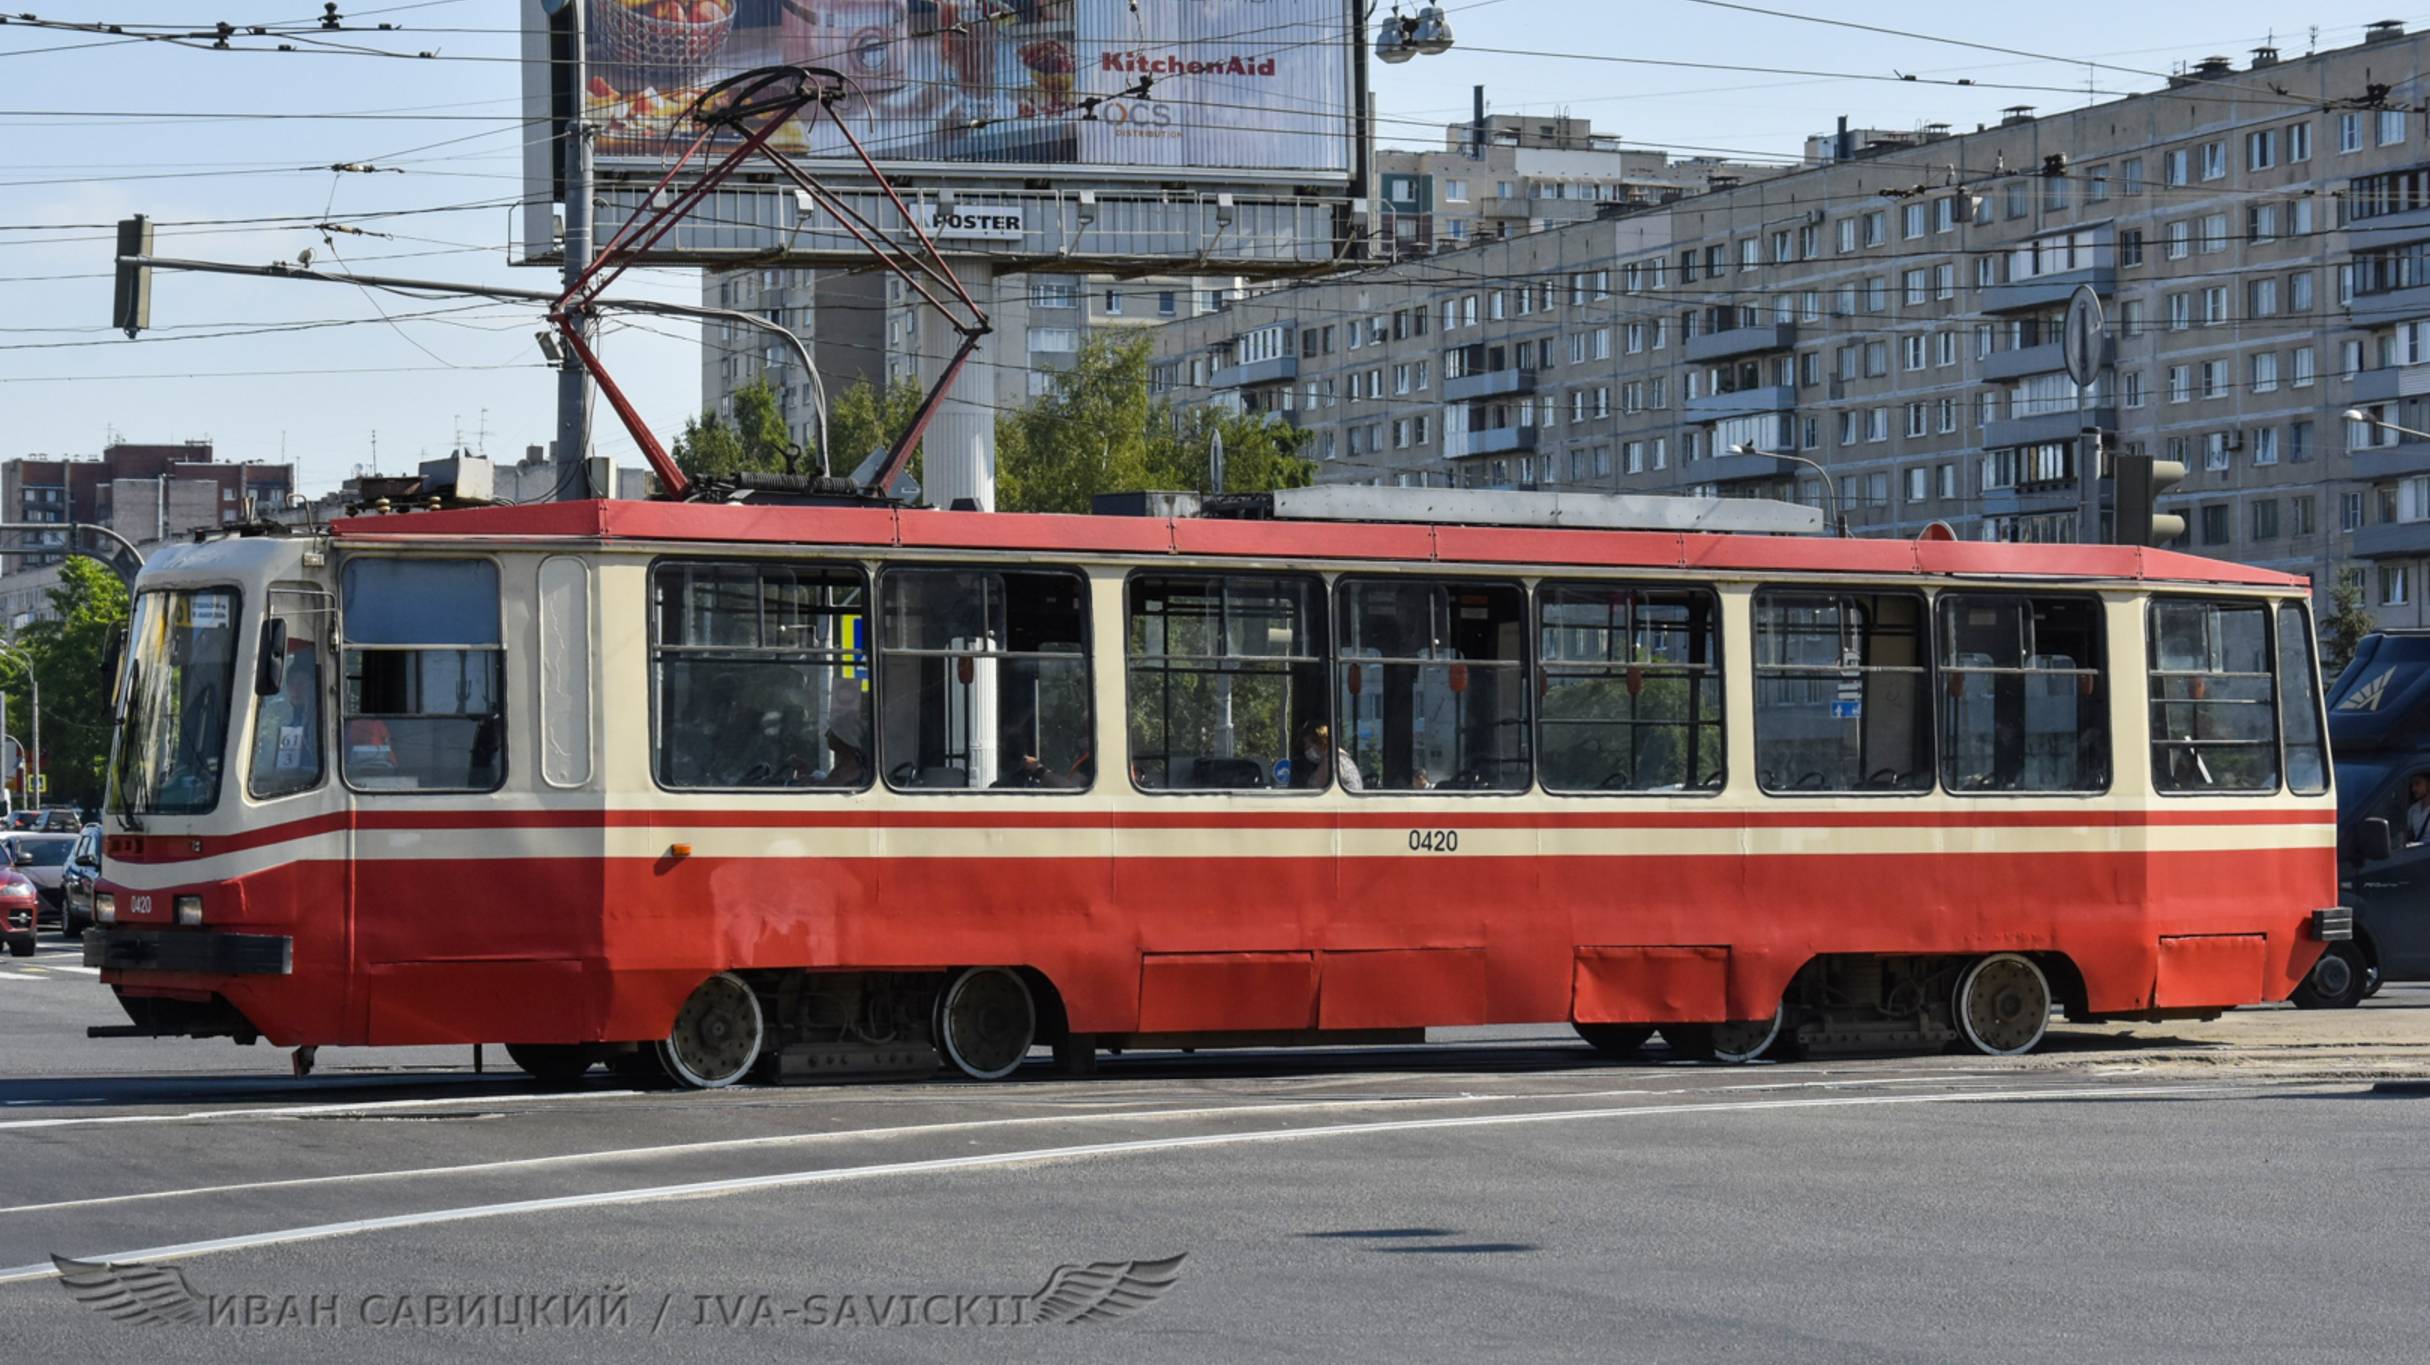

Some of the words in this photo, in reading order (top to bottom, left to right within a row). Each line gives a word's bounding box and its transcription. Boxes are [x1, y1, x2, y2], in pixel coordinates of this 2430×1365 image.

[1102, 51, 1276, 77] KitchenAid
[1409, 829, 1458, 852] 0420
[131, 895, 152, 913] 0420
